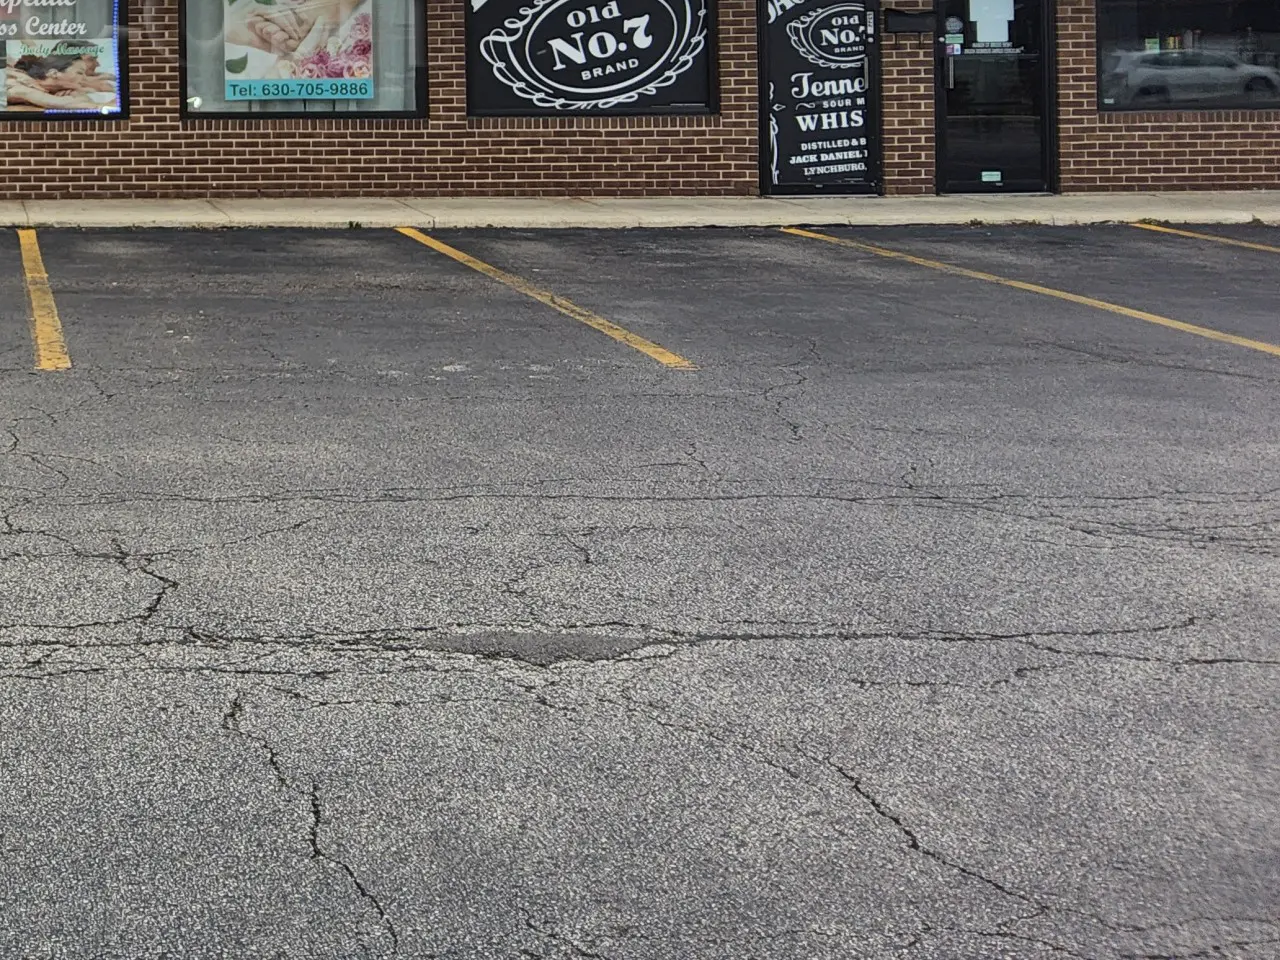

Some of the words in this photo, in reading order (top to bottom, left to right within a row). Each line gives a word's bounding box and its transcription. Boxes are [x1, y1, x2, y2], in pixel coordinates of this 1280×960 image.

[566, 0, 621, 28] Old
[831, 15, 859, 26] Old
[25, 16, 87, 36] Center
[834, 45, 865, 53] BRAND
[580, 58, 640, 81] BRAND
[229, 84, 256, 96] Tel:
[261, 82, 368, 96] 630-705-9886
[822, 98, 852, 108] SOUR
[795, 110, 864, 131] WHIS
[801, 139, 849, 150] DISTILLED
[851, 138, 858, 146] &
[789, 154, 818, 164] JACK
[820, 150, 863, 161] DANIEL
